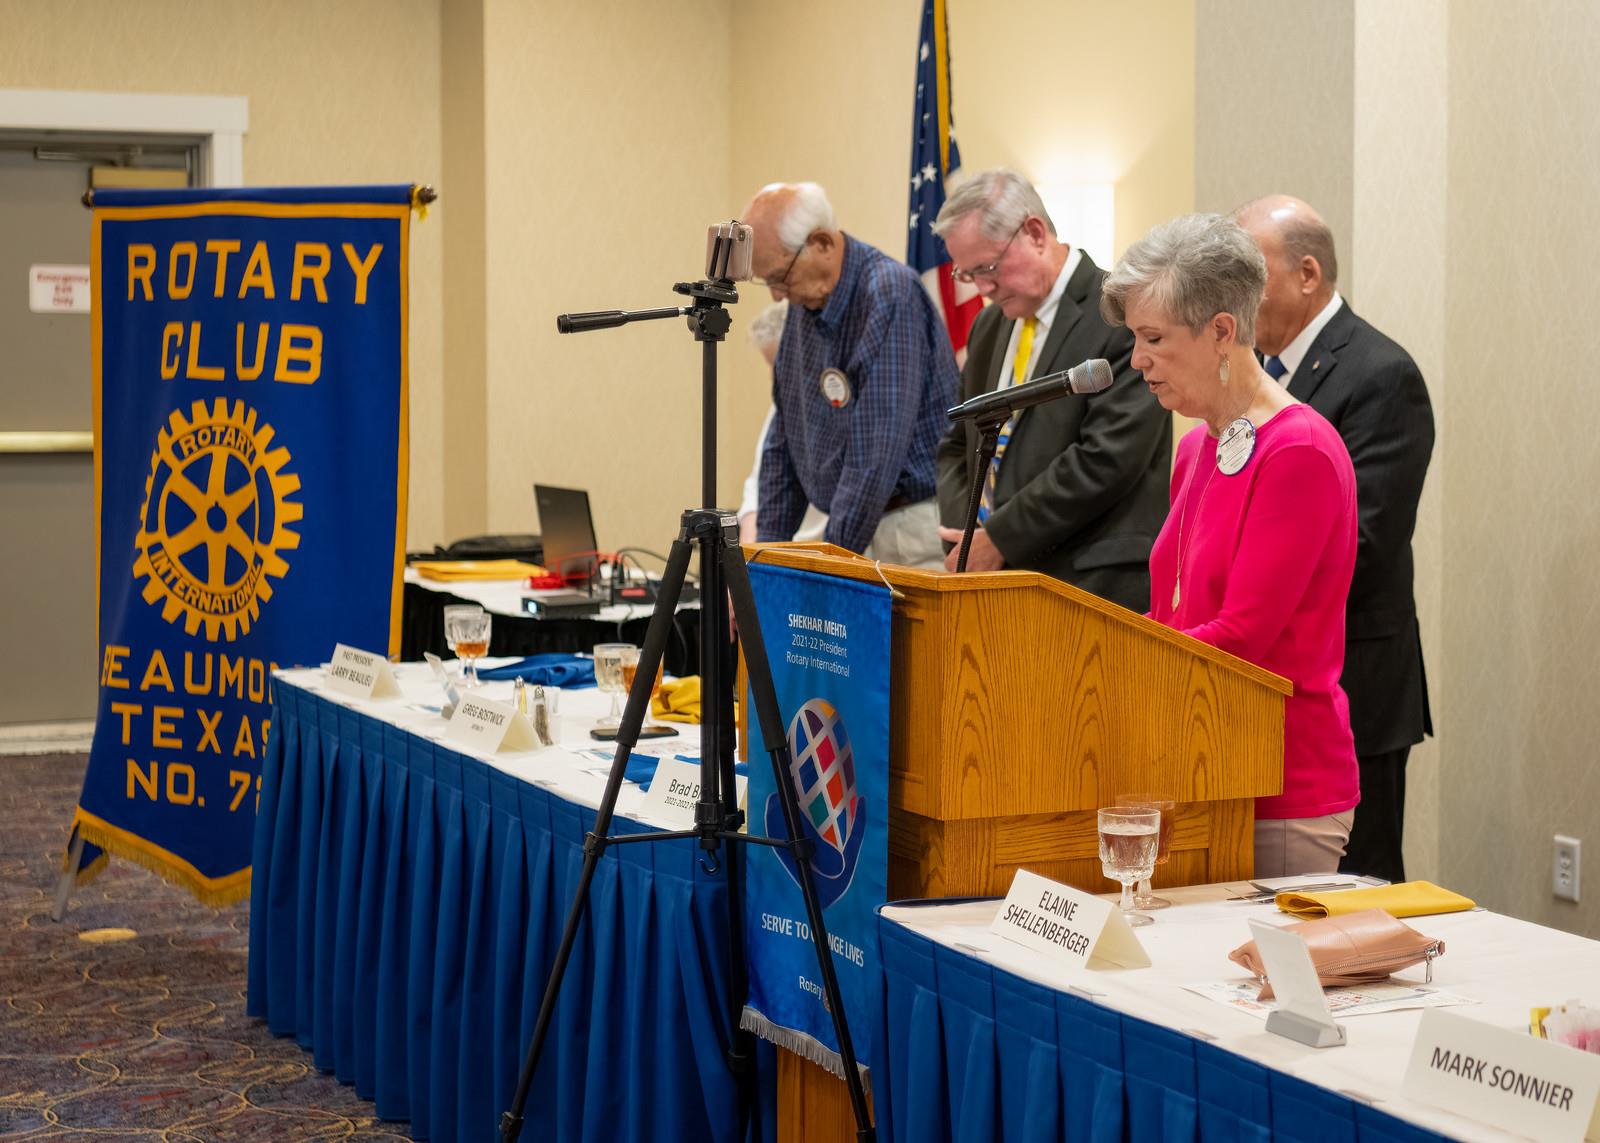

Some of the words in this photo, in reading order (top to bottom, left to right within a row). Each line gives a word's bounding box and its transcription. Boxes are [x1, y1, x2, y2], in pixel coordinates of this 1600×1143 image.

[127, 239, 383, 305] ROTARY
[160, 321, 324, 385] CLUB
[178, 425, 255, 461] ROTARY
[150, 549, 262, 615] INTERNATIONAL
[788, 613, 823, 633] SHEKHAR
[823, 620, 847, 639] MEHTA
[791, 633, 818, 650] 2021-22
[819, 639, 848, 658] President
[101, 644, 279, 704] EAUMO
[786, 651, 810, 669] Rotary
[810, 656, 850, 678] International
[462, 703, 480, 718] GREG
[477, 708, 506, 727] BOSTWICK
[126, 758, 206, 808] NO.
[229, 769, 262, 816] 7
[664, 796, 690, 809] 2021-2022
[668, 778, 693, 797] Brad
[1038, 890, 1079, 922] ELAINE
[761, 912, 793, 936] SERVE
[795, 921, 809, 939] TO
[845, 941, 864, 967] LIVES
[1003, 903, 1090, 957] SHELLENBERGER
[799, 975, 823, 1000] Rotary
[1429, 1046, 1488, 1083] MARK
[1488, 1065, 1574, 1112] SONNIER
